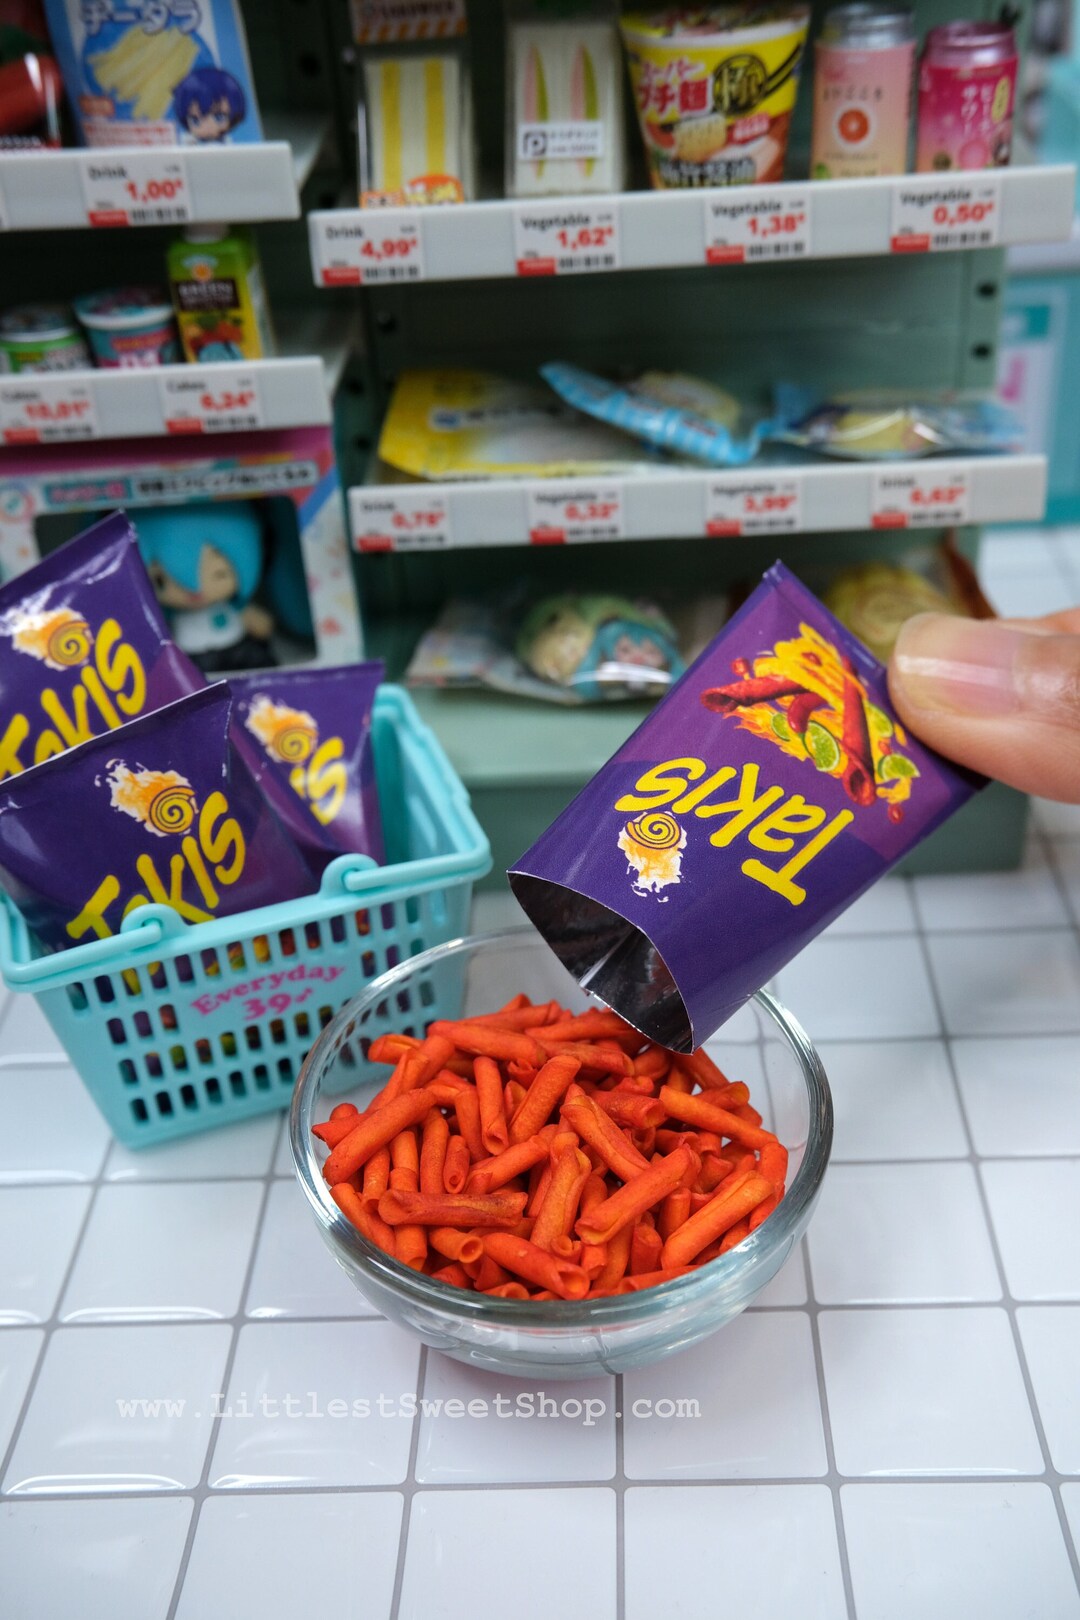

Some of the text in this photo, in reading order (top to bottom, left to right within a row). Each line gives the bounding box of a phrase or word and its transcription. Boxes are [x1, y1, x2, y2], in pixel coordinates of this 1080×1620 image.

[88, 165, 127, 180] Drink
[900, 186, 972, 208] Vegetable
[711, 198, 782, 219] Vegetable
[325, 224, 363, 239] Drink
[521, 212, 591, 233] Vegetable
[190, 964, 345, 1016] Everyday
